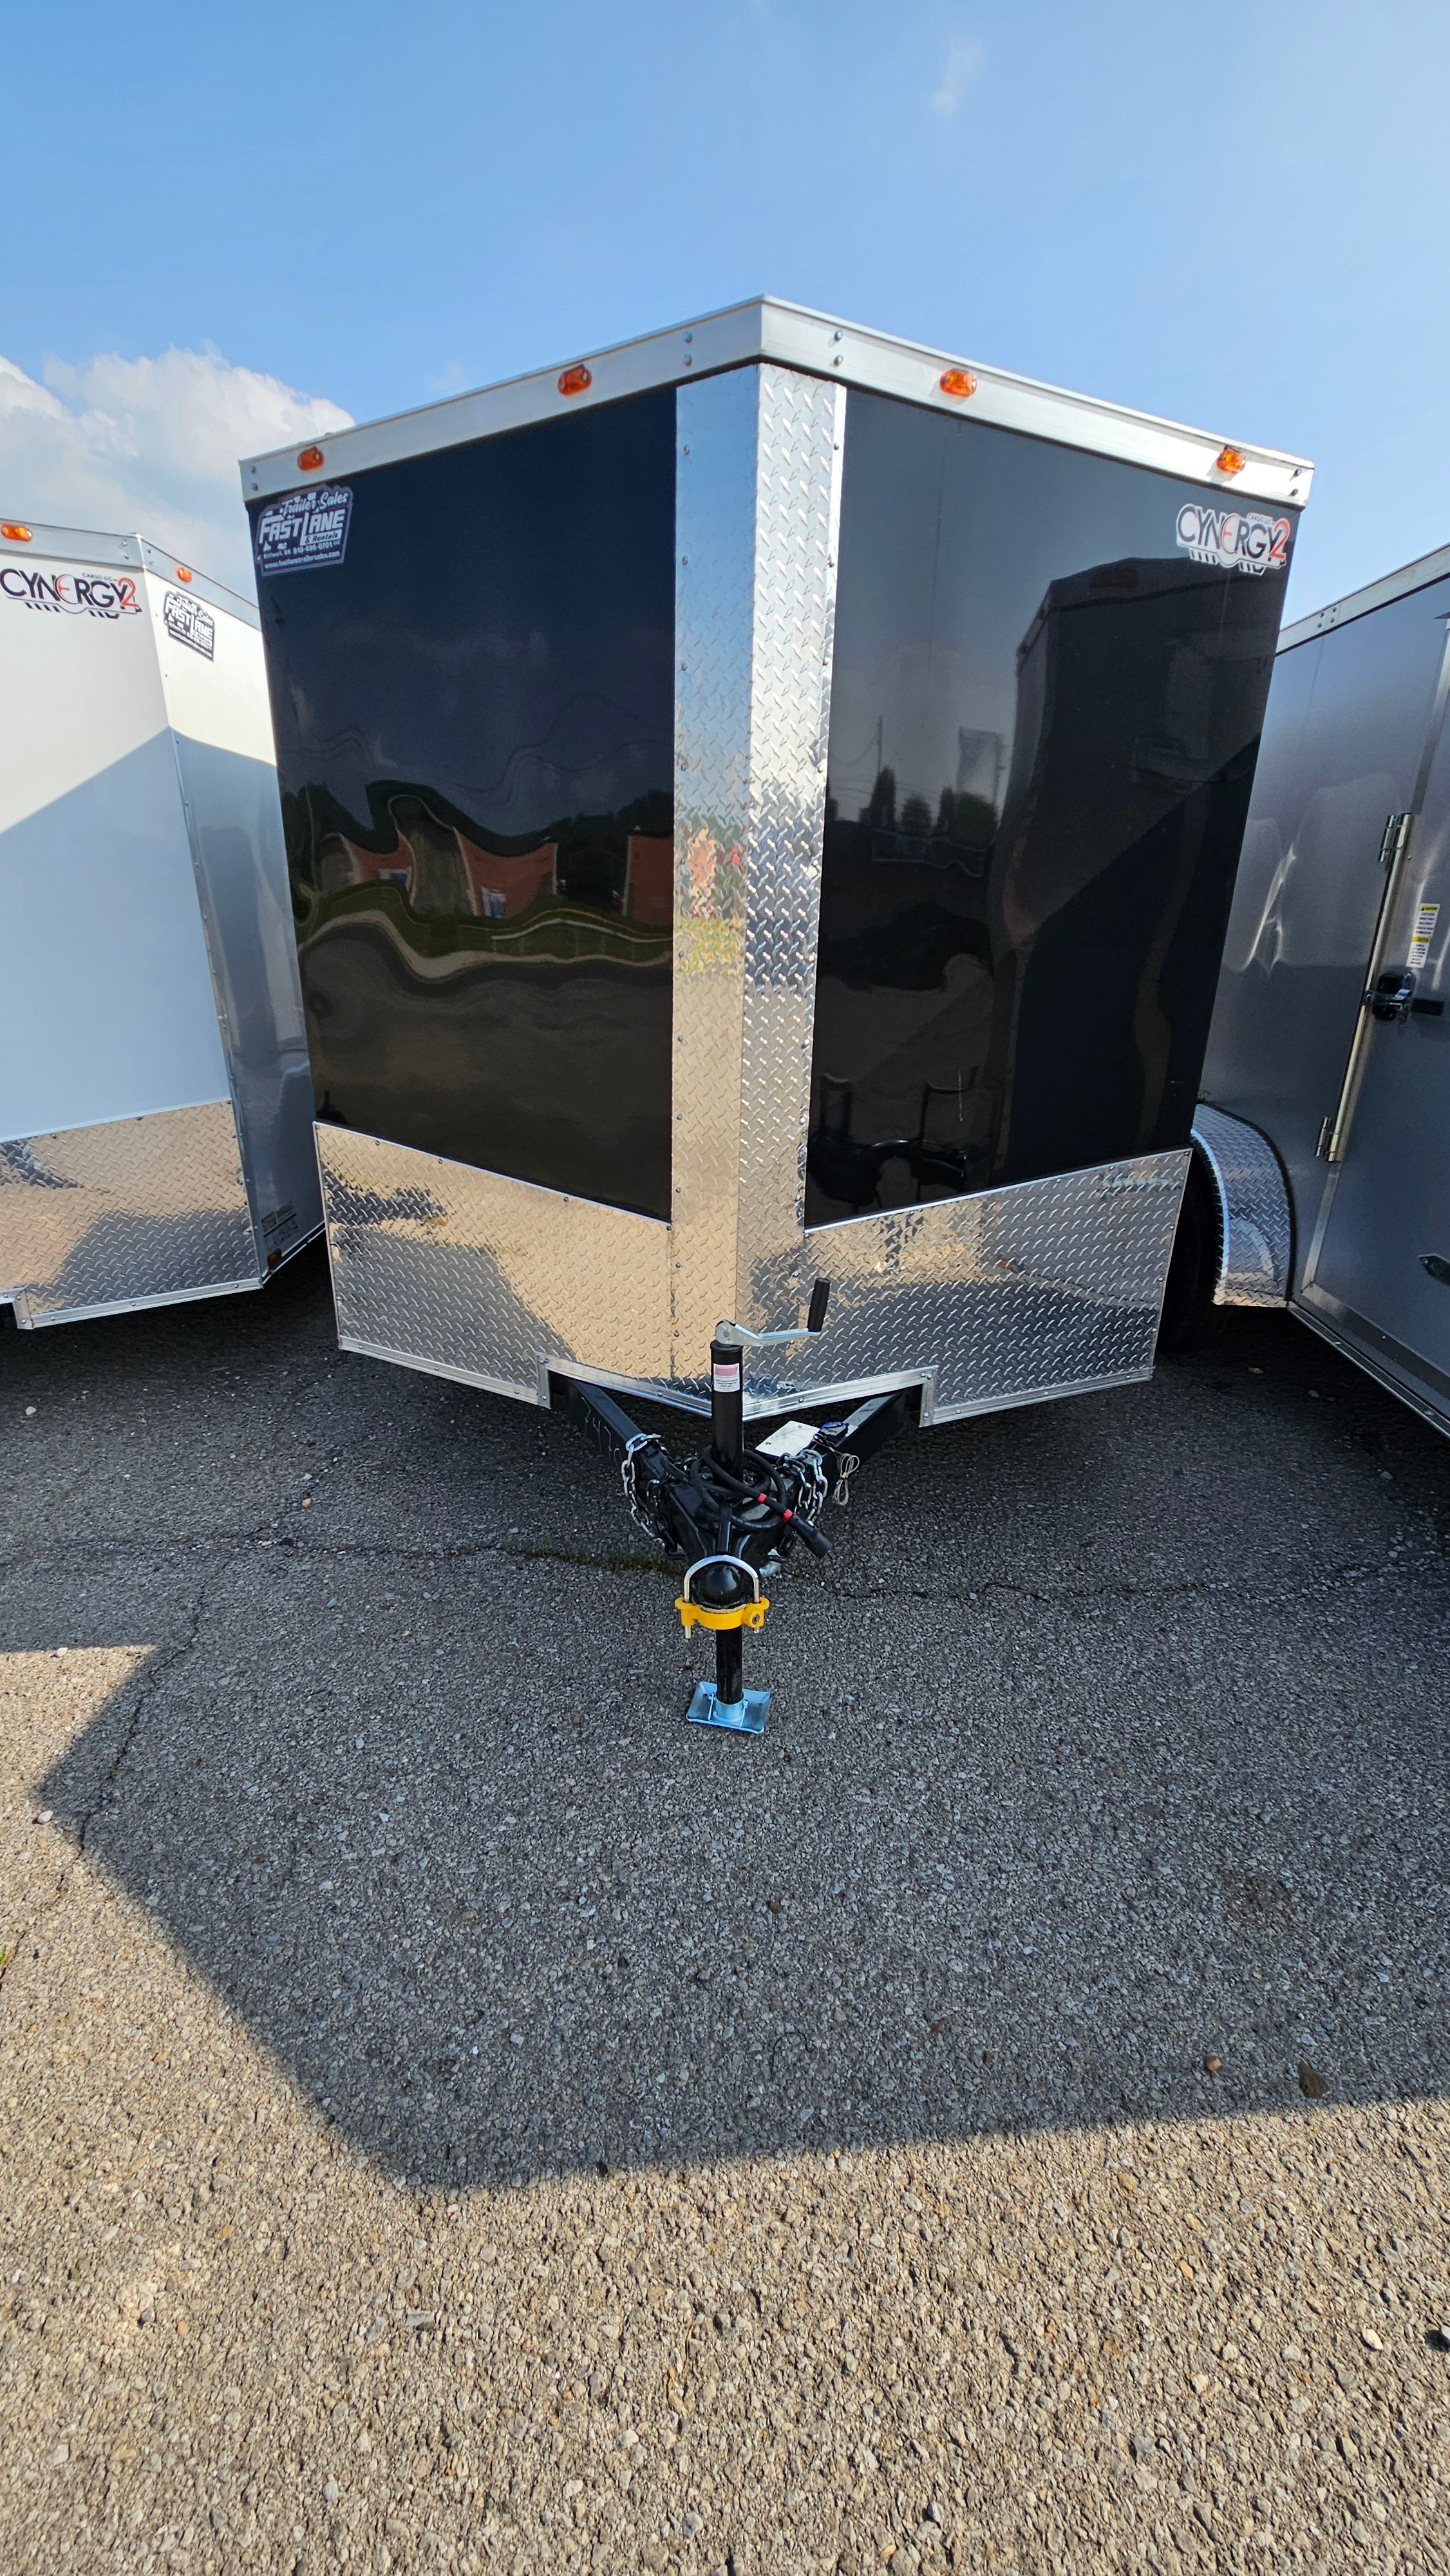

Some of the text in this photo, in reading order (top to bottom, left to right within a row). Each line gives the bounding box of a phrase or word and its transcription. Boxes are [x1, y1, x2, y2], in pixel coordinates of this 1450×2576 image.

[281, 491, 348, 516] Trailer Sales
[259, 509, 346, 546] FAST LANE
